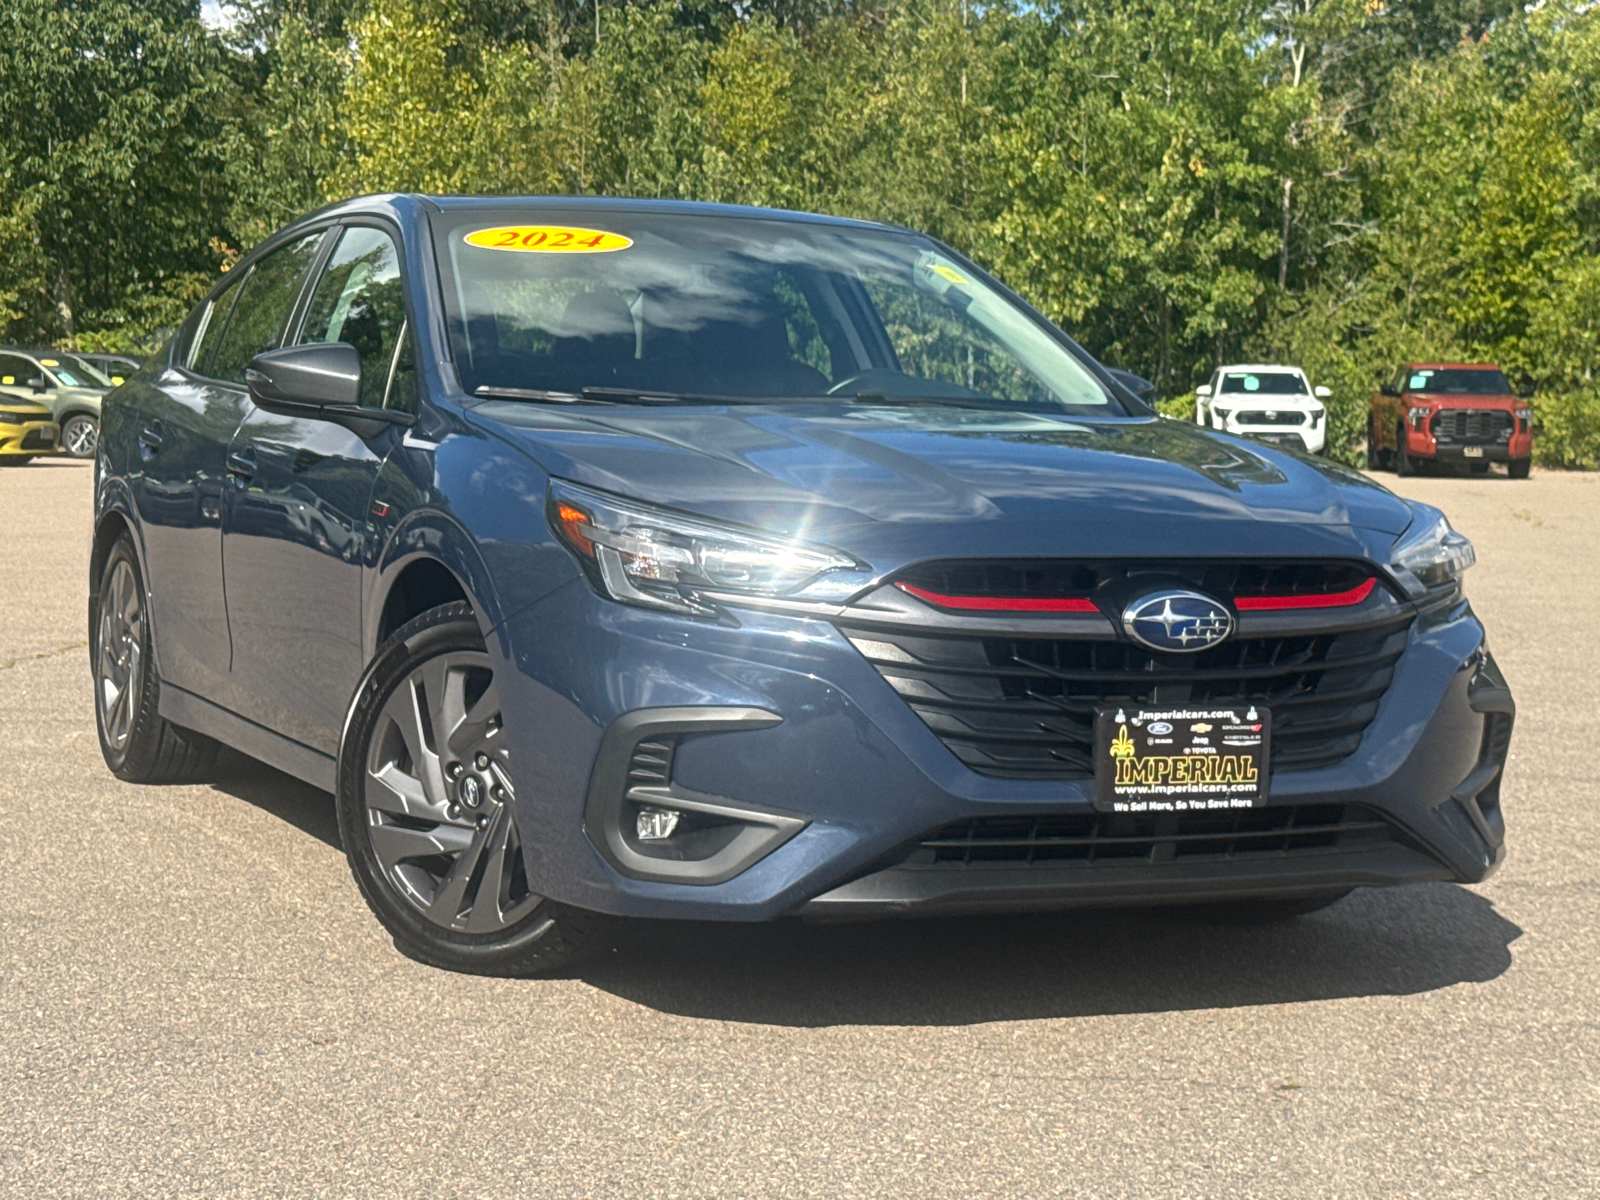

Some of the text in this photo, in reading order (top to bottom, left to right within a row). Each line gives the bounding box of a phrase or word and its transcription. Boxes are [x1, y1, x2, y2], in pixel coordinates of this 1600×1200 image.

[491, 231, 606, 248] 2024
[1138, 709, 1234, 721] Imperialcars.com
[1191, 735, 1210, 746] Jeep
[1191, 746, 1217, 754] TOYOTA
[1115, 755, 1258, 784] IMPERIAL
[1114, 783, 1257, 795] www.imperialcars.com
[1113, 802, 1129, 812] We
[1130, 801, 1147, 812] Sell
[1176, 800, 1187, 810] So
[1189, 800, 1206, 809] You
[1207, 799, 1229, 809] Save
[1230, 799, 1252, 808] More
